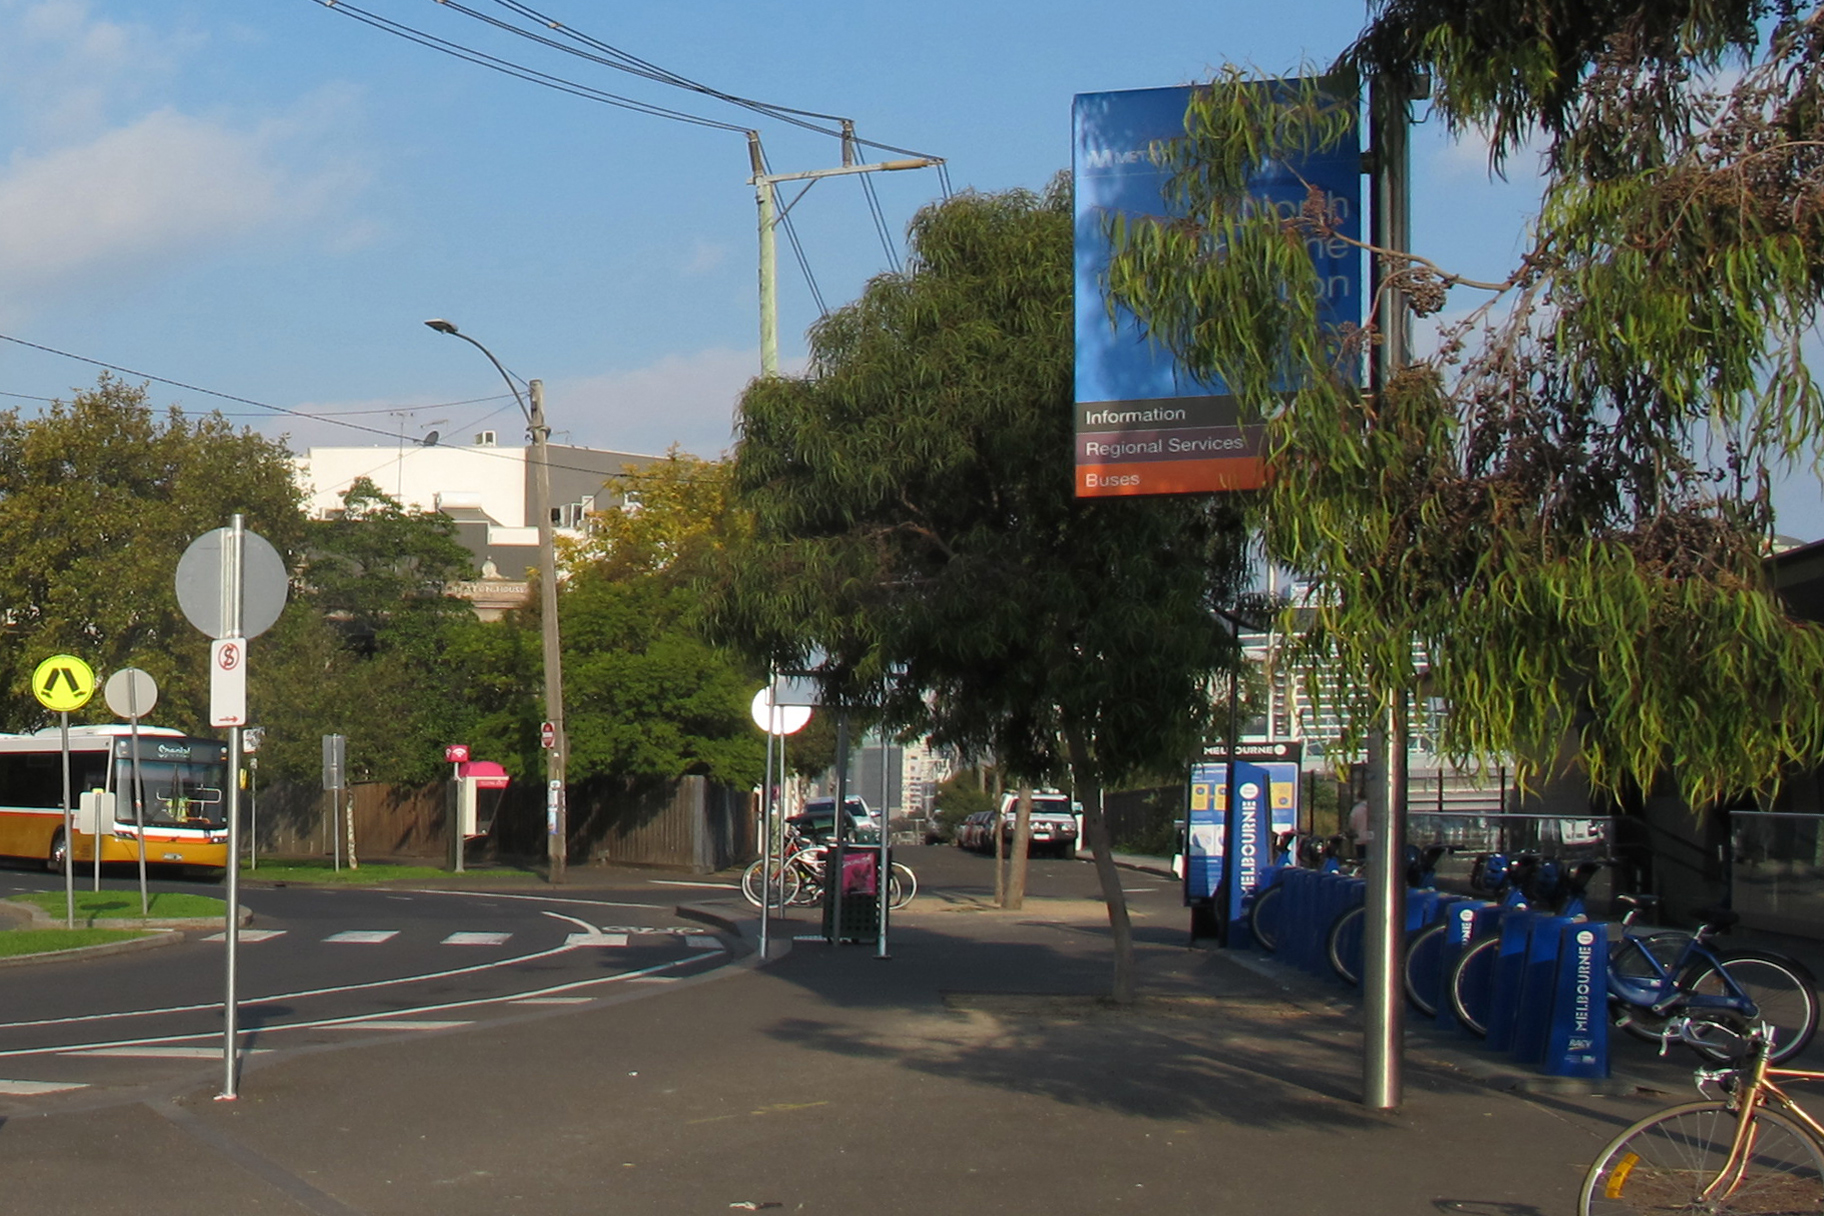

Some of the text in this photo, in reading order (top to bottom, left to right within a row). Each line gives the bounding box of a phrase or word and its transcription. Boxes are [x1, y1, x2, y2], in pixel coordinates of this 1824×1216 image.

[1086, 407, 1186, 425] Information
[1086, 437, 1244, 458] Regional Services
[1085, 473, 1141, 488] Buses
[1203, 746, 1274, 756] MELOURNE
[1240, 800, 1257, 898] MELBOURNE
[1575, 946, 1592, 1032] MELBOURNE
